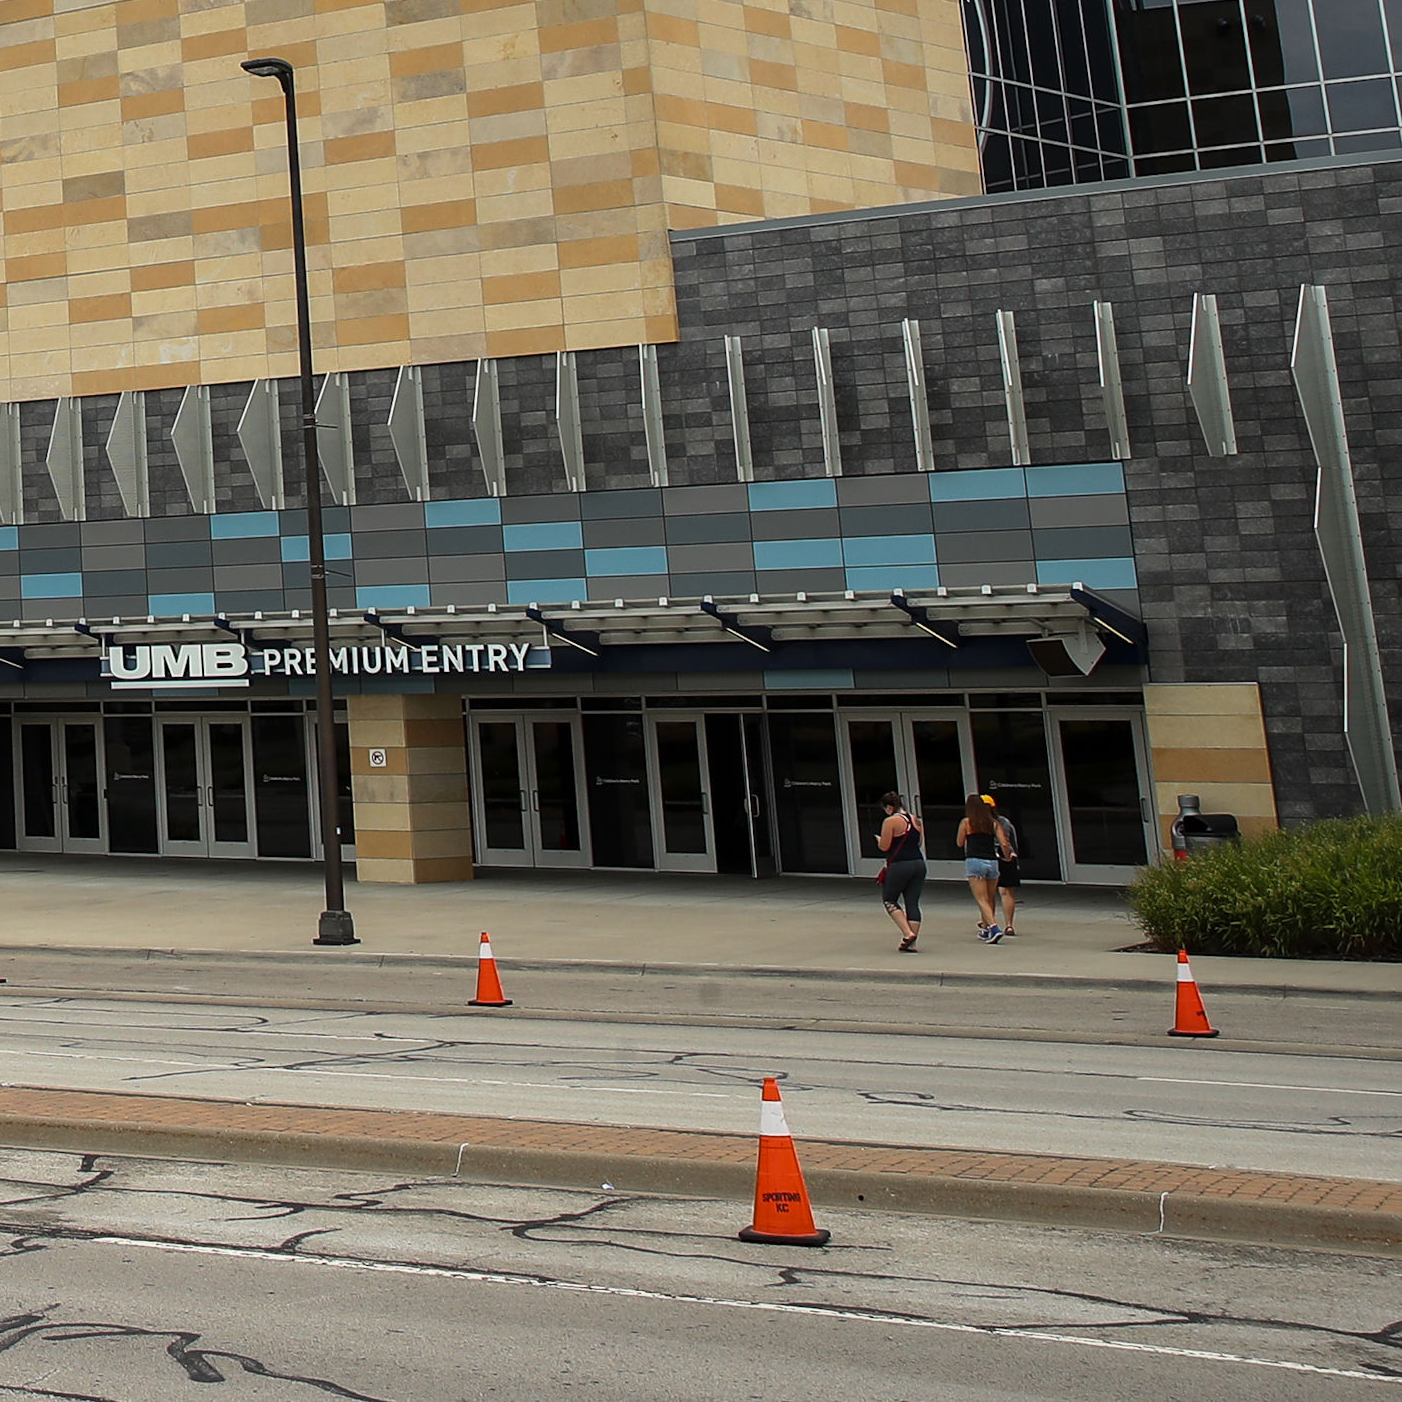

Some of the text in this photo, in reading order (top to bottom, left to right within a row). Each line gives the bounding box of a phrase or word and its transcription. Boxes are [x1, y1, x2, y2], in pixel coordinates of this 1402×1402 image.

[109, 642, 531, 680] UMB PREMIUM ENTRY
[762, 1192, 802, 1202] SPORTING
[776, 1203, 789, 1213] KC
